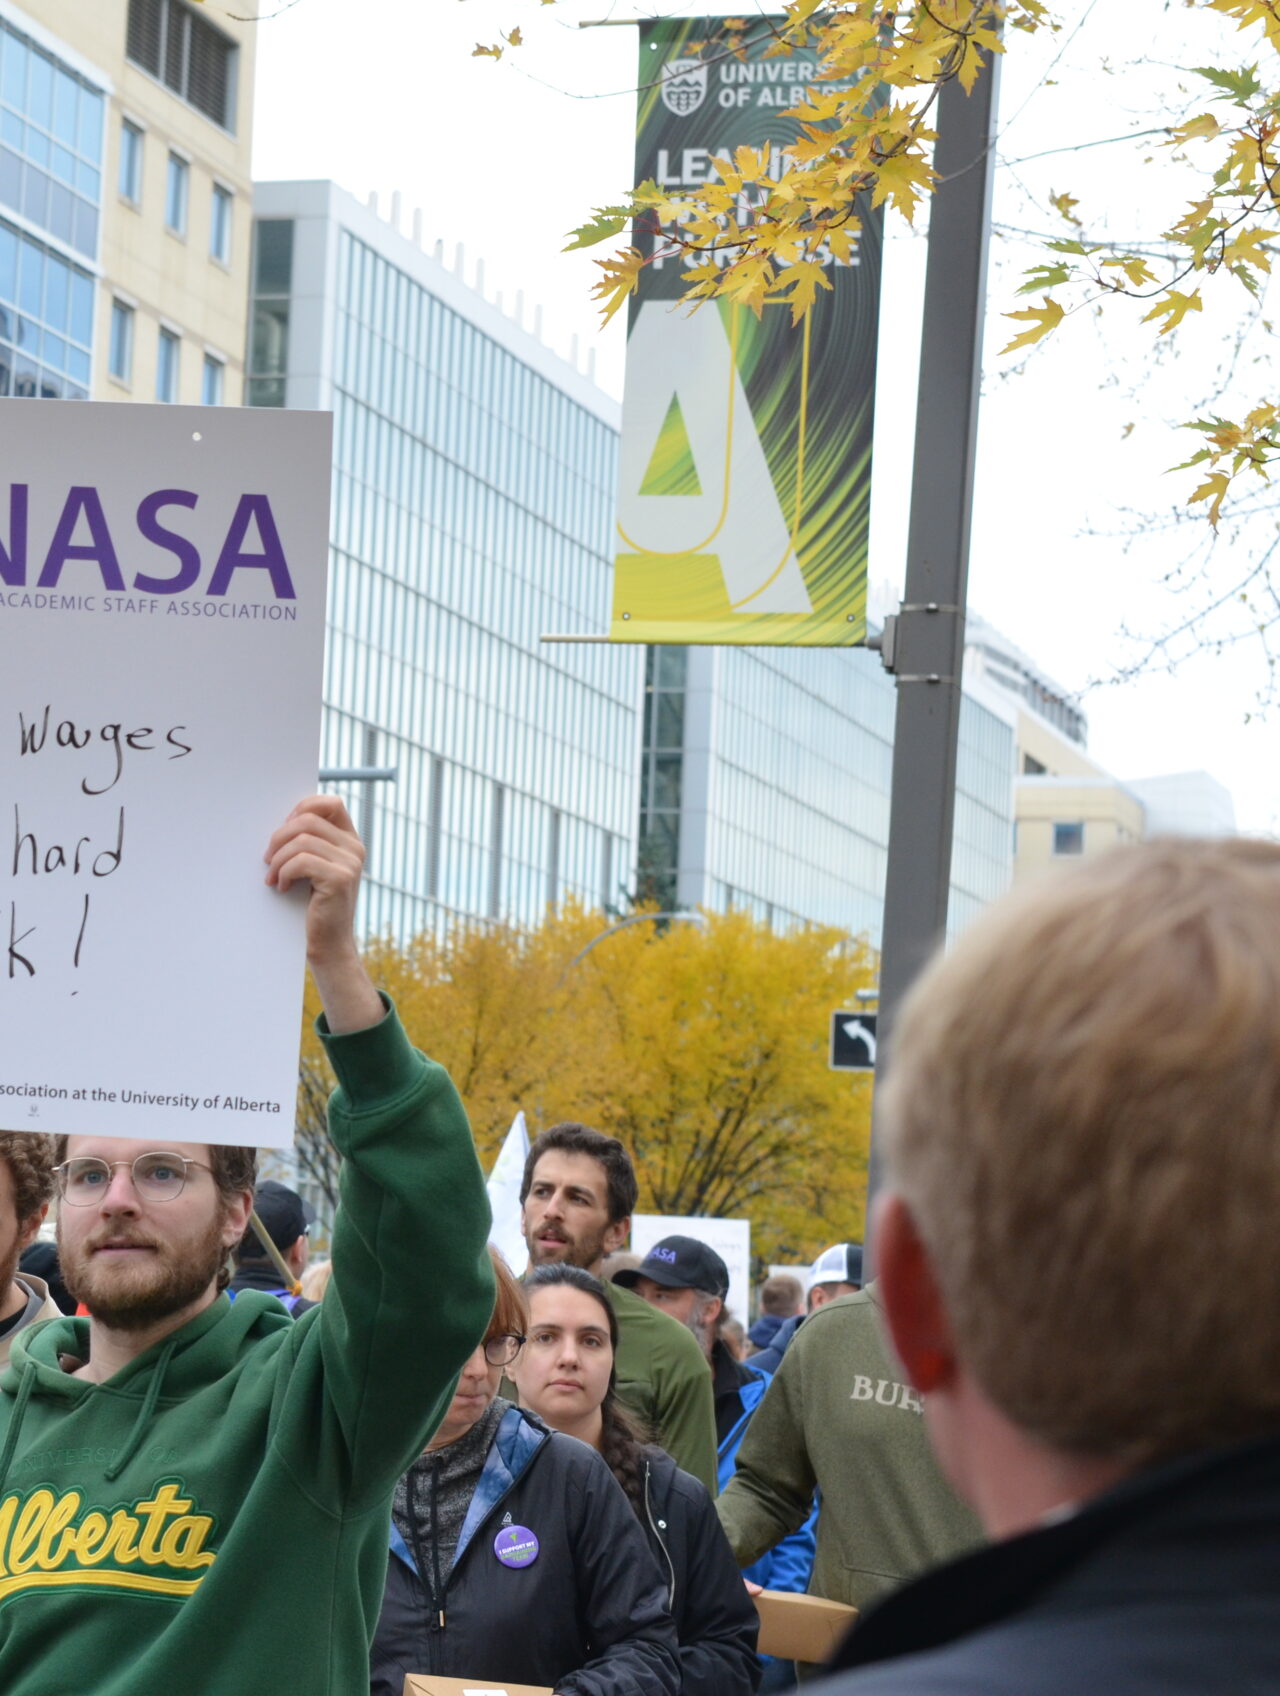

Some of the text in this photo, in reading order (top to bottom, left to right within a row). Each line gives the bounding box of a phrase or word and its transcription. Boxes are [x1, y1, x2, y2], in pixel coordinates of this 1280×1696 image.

[718, 87, 751, 108] OF
[103, 597, 159, 615] STAFF
[166, 600, 298, 622] ASSOCIATION
[12, 803, 125, 877] hard
[72, 1088, 87, 1100] at
[91, 1087, 117, 1102] the
[121, 1090, 200, 1111] University
[203, 1095, 221, 1109] of
[223, 1096, 281, 1113] Alberta
[649, 1246, 677, 1264] ASA
